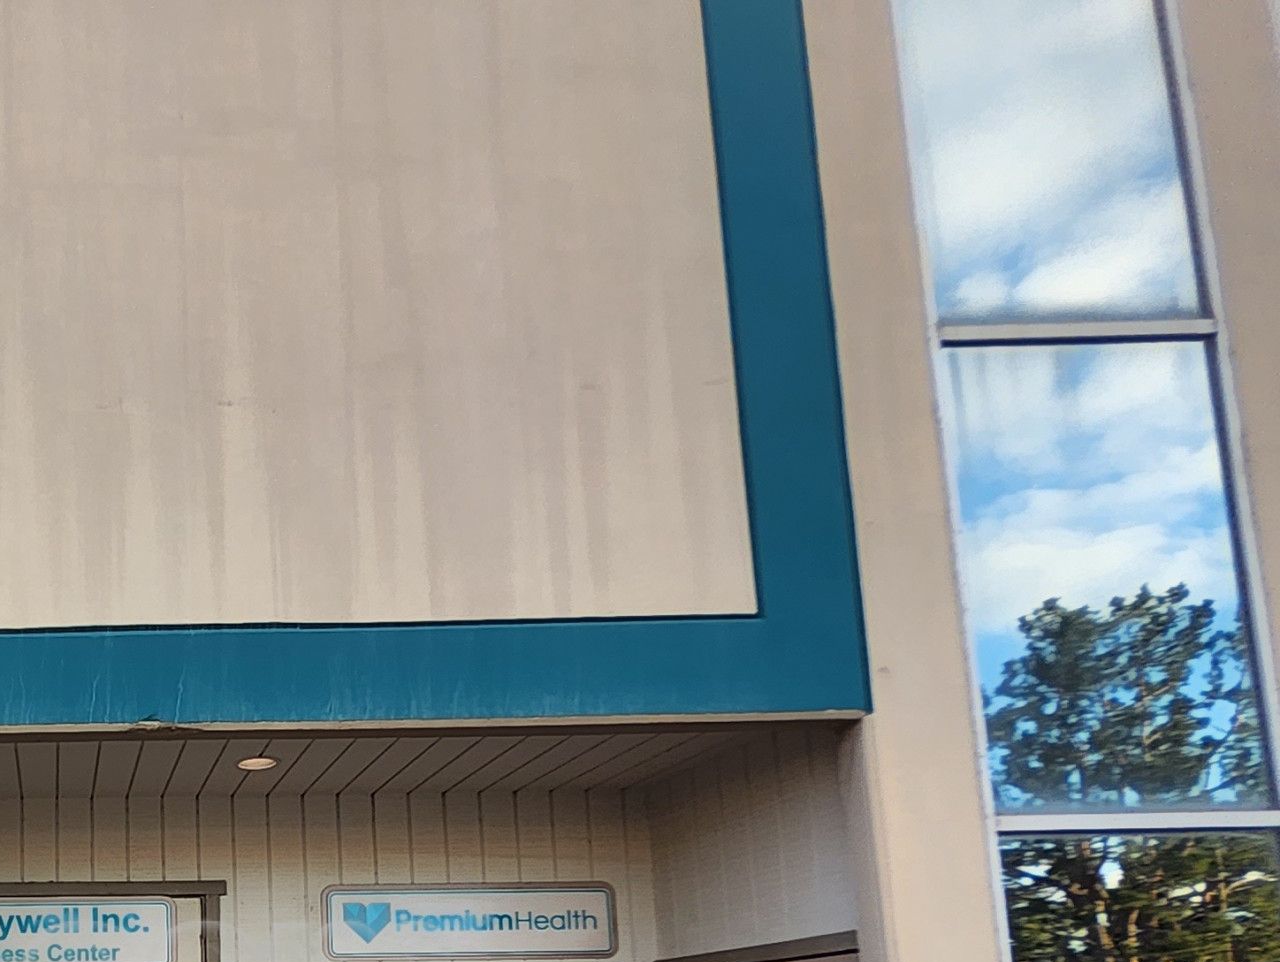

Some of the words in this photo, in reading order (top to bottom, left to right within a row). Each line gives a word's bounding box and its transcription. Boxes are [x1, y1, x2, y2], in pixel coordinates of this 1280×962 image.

[92, 906, 150, 933] Inc.
[395, 909, 598, 932] PremiumHealth
[47, 943, 121, 962] Center
